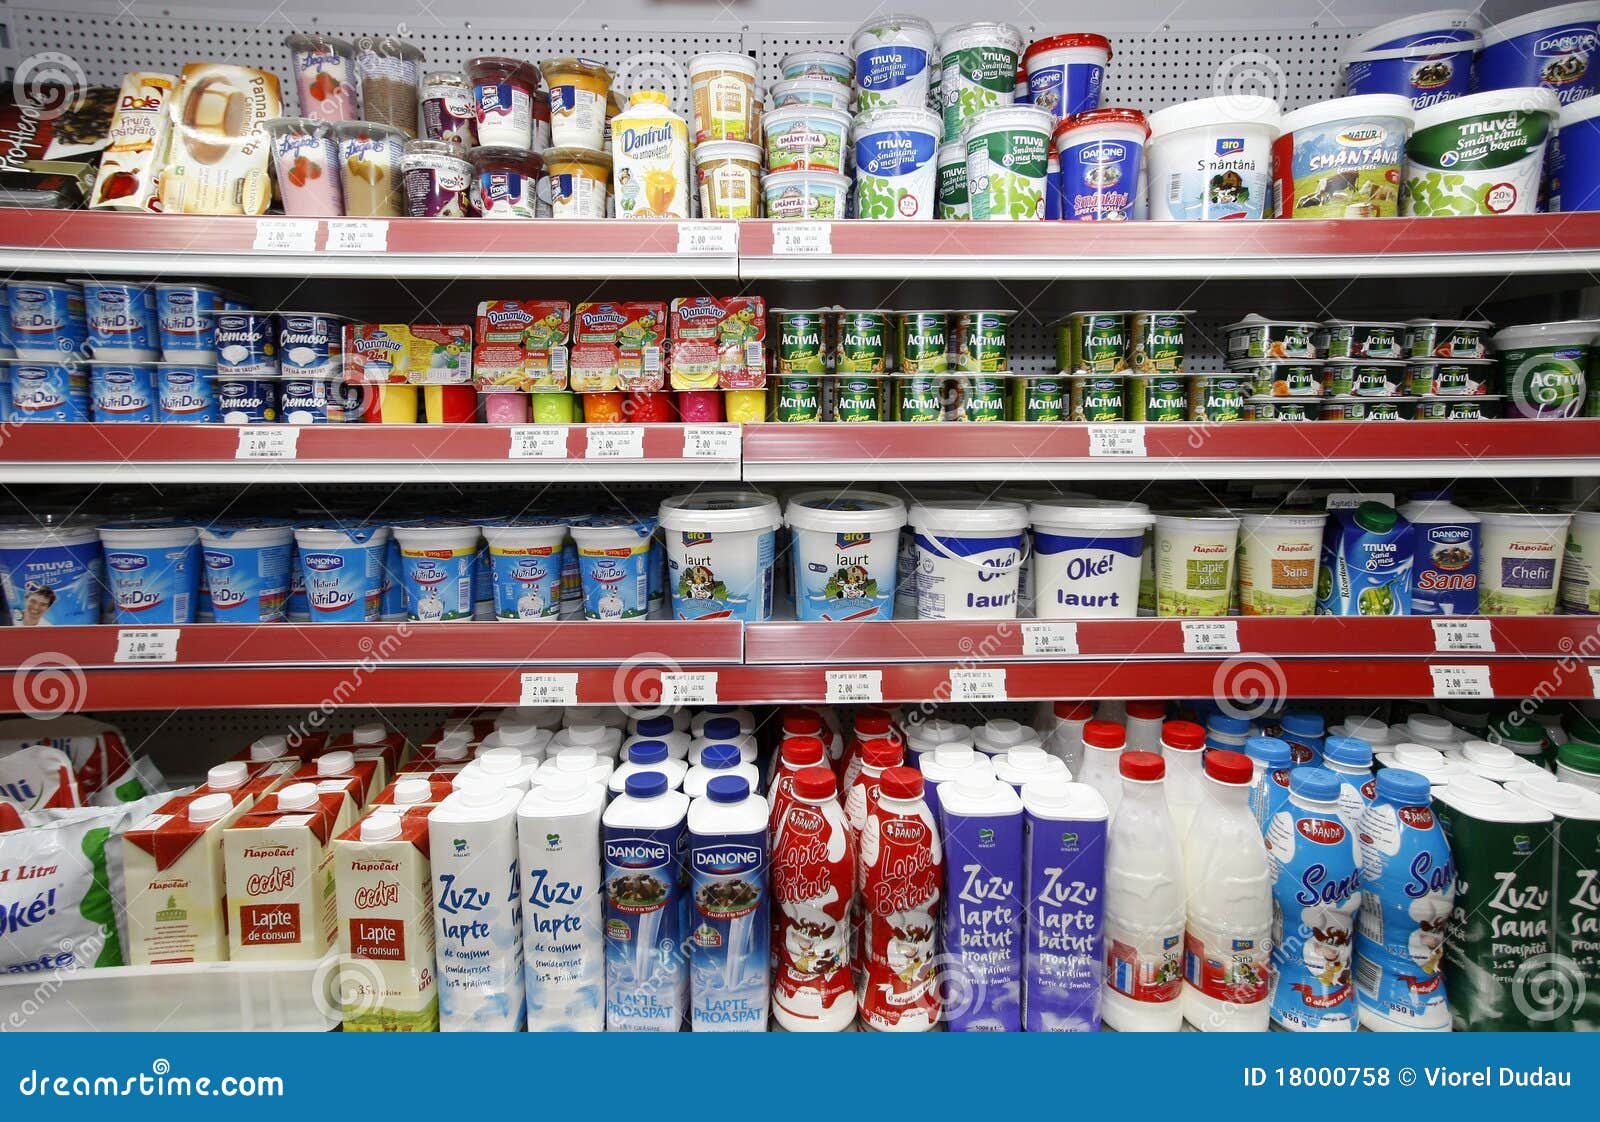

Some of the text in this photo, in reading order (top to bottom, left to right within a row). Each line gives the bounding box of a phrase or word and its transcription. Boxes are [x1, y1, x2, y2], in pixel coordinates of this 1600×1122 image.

[122, 95, 161, 109] Dole
[624, 119, 673, 153] Danfruit
[1456, 129, 1523, 151] Smântâna
[1222, 140, 1239, 149] aro
[1460, 136, 1528, 162] mea bogată
[1083, 147, 1124, 160] DANONE
[268, 232, 285, 241] 2.00
[340, 233, 356, 242] 2.00
[690, 236, 706, 244] 2.00
[785, 237, 801, 245] 2.00
[488, 309, 533, 325] Danonino
[680, 304, 726, 320] Danonino
[582, 312, 628, 326] Danonino
[281, 329, 328, 347] Cremoso
[782, 333, 819, 346] ACTIVIA
[845, 334, 882, 347] ACTIVIA
[907, 334, 944, 347] ACTIVIA
[969, 334, 1006, 347] ACTIVIA
[1085, 334, 1122, 347] ACTIVIA
[1146, 334, 1184, 347] ACTIVIA
[355, 338, 403, 352] Danonino
[282, 393, 328, 411] Cremoso
[780, 396, 817, 409] ACTIVIA
[839, 397, 876, 410] ACTIVIA
[902, 397, 940, 410] ACTIVIA
[966, 397, 1003, 410] ACTIVIA
[1028, 398, 1063, 410] ACTIVIA
[1085, 396, 1122, 409] ACTIVIA
[1149, 397, 1184, 409] ACTIVIA
[1207, 396, 1244, 409] ACTIVIA
[250, 440, 266, 449] 2.00
[522, 440, 538, 449] 2.00
[598, 440, 614, 449] 2.00
[696, 439, 711, 448] 2.00
[1101, 438, 1116, 448] 2.00
[1432, 529, 1470, 540] DANONE
[305, 556, 341, 566] DANONE
[684, 553, 712, 566] Iaurt
[836, 552, 870, 566] Iaurt
[1370, 551, 1390, 560] Sana
[412, 568, 446, 580] NutriDay
[511, 567, 546, 580] NutriDay
[592, 567, 626, 579] NutriDay
[1066, 554, 1114, 581] Oké!
[1197, 560, 1225, 575] Lapte
[1283, 565, 1309, 578] Sana
[1511, 565, 1550, 581] Chefir
[313, 577, 339, 588] Natural
[1418, 569, 1477, 591] Sana
[309, 590, 355, 606] NutriDay
[967, 589, 1017, 608] Iaurt
[1057, 589, 1119, 608] Iaurt
[1034, 636, 1049, 646] 2.00
[1196, 633, 1210, 643] 2.00
[1447, 632, 1463, 643] 2.00
[130, 642, 146, 652] 2.00
[673, 684, 688, 694] 2.00
[838, 683, 853, 693] 2.00
[963, 682, 977, 692] 2.00
[1446, 678, 1461, 688] 2.00
[532, 686, 548, 696] 2.00
[795, 816, 819, 830] PANDA
[894, 826, 921, 838] PANDA
[1312, 824, 1342, 838] PANDA
[243, 848, 296, 859] Napolact
[607, 844, 665, 859] DANONE
[696, 851, 757, 864] DANONE
[777, 834, 829, 868] Lapte
[351, 860, 399, 872] Napolact
[883, 845, 934, 881] Lapte
[16, 863, 58, 881] Litru
[149, 880, 190, 890] Napolact
[529, 868, 583, 909] Zuzu
[958, 864, 1014, 904] Zuzu
[1038, 867, 1097, 907] Zuzu
[1297, 863, 1361, 907] Sana
[438, 874, 491, 915] Zuzu
[874, 871, 936, 917] Bătut
[1488, 871, 1549, 914] Zuzu
[253, 909, 292, 930] Lapte
[959, 904, 1013, 934] lapte
[1038, 905, 1095, 936] lapte
[442, 917, 490, 946] lapte
[533, 912, 582, 940] lapte
[249, 930, 296, 941] de consum
[360, 923, 396, 944] Lapte
[960, 928, 1014, 948] bătut
[1039, 930, 1096, 951] bătut
[357, 946, 400, 956] de consum
[444, 948, 490, 960] de consum
[535, 943, 582, 953] de consum
[1492, 942, 1547, 959] proaspătă
[535, 958, 583, 970] semidegresat
[961, 948, 1011, 967] proaspăt
[1039, 952, 1092, 970] proaspăt
[1232, 954, 1253, 963] Sana
[445, 964, 491, 977] semidegresat
[706, 997, 747, 1012] LAPTE
[1390, 1003, 1407, 1014] 850
[694, 1008, 763, 1024] PROASPĂT
